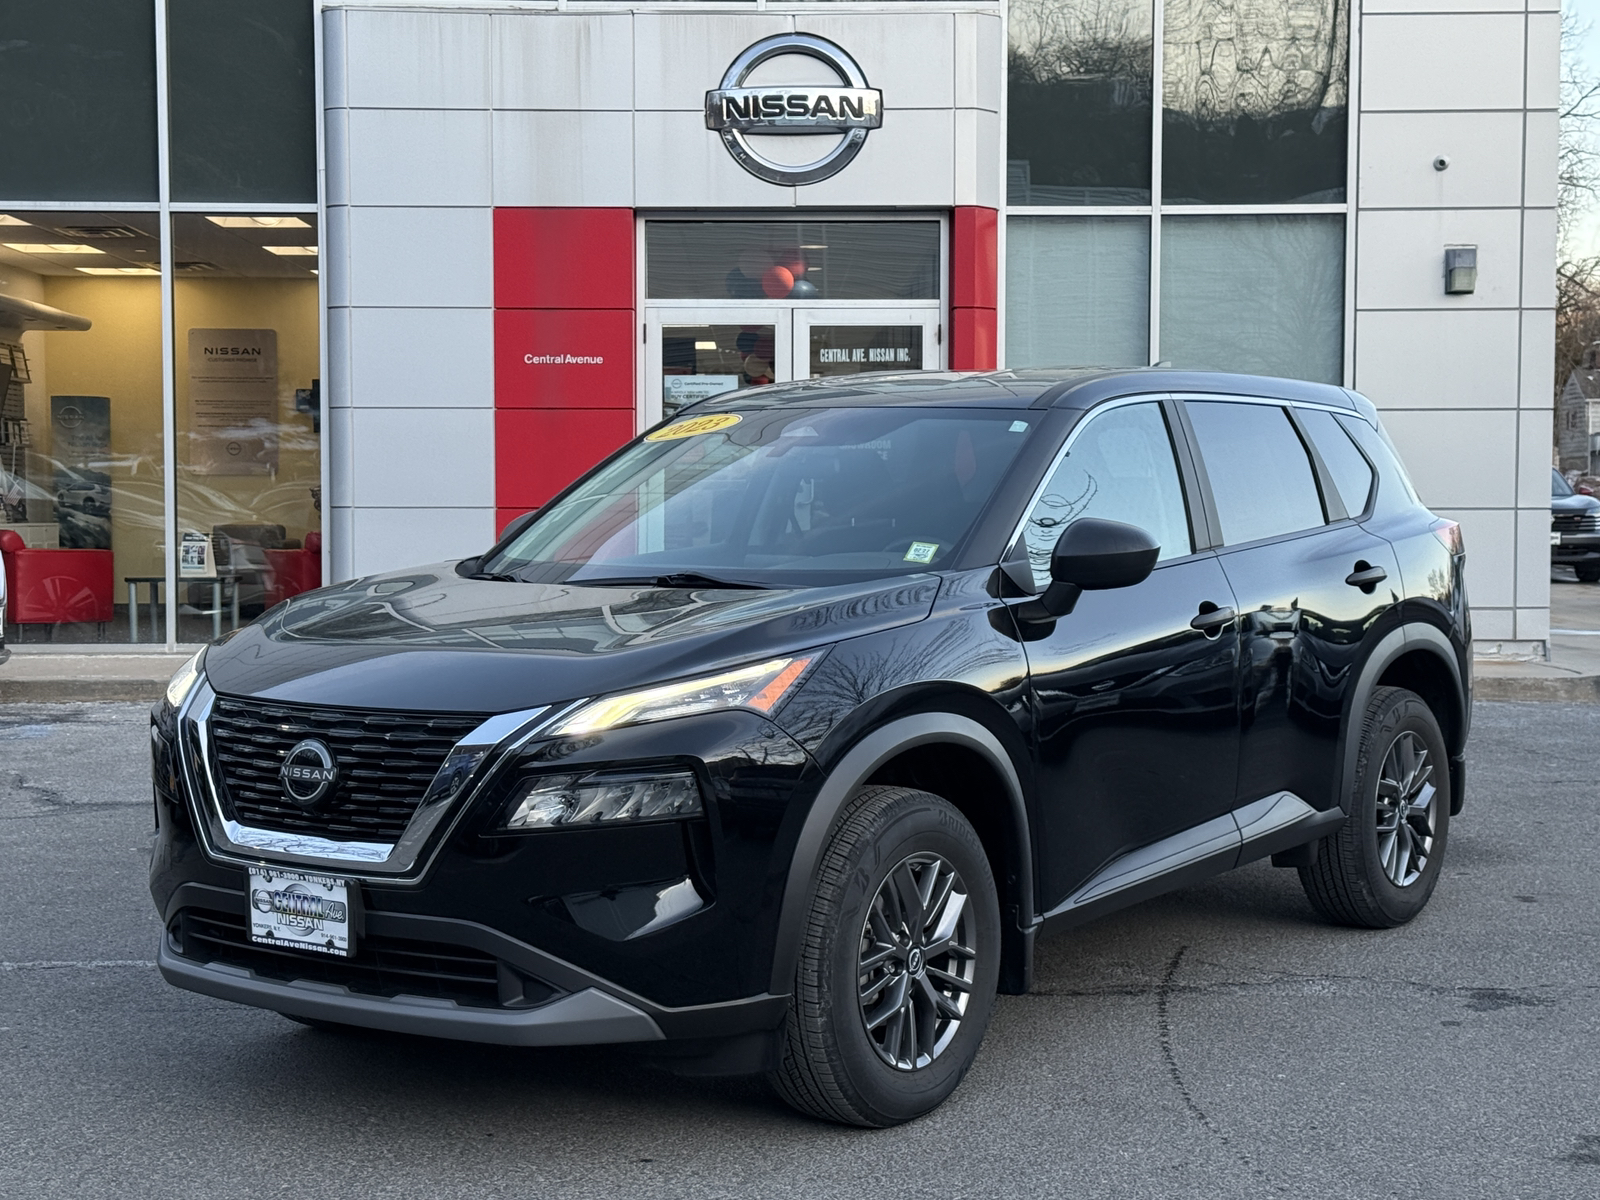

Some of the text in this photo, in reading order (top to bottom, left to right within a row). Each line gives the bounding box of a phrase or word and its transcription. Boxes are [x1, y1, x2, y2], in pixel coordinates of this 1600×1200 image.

[723, 94, 865, 120] NISSAN
[204, 347, 261, 355] NISSAN
[524, 353, 604, 364] Central Avenue
[820, 348, 911, 362] CENTRAL AVE. NISSAN INC.
[281, 765, 334, 780] NISSAN
[273, 890, 324, 917] CENTRAL
[277, 914, 324, 931] NISSAN
[251, 935, 347, 957] CentralAveNissan.com
